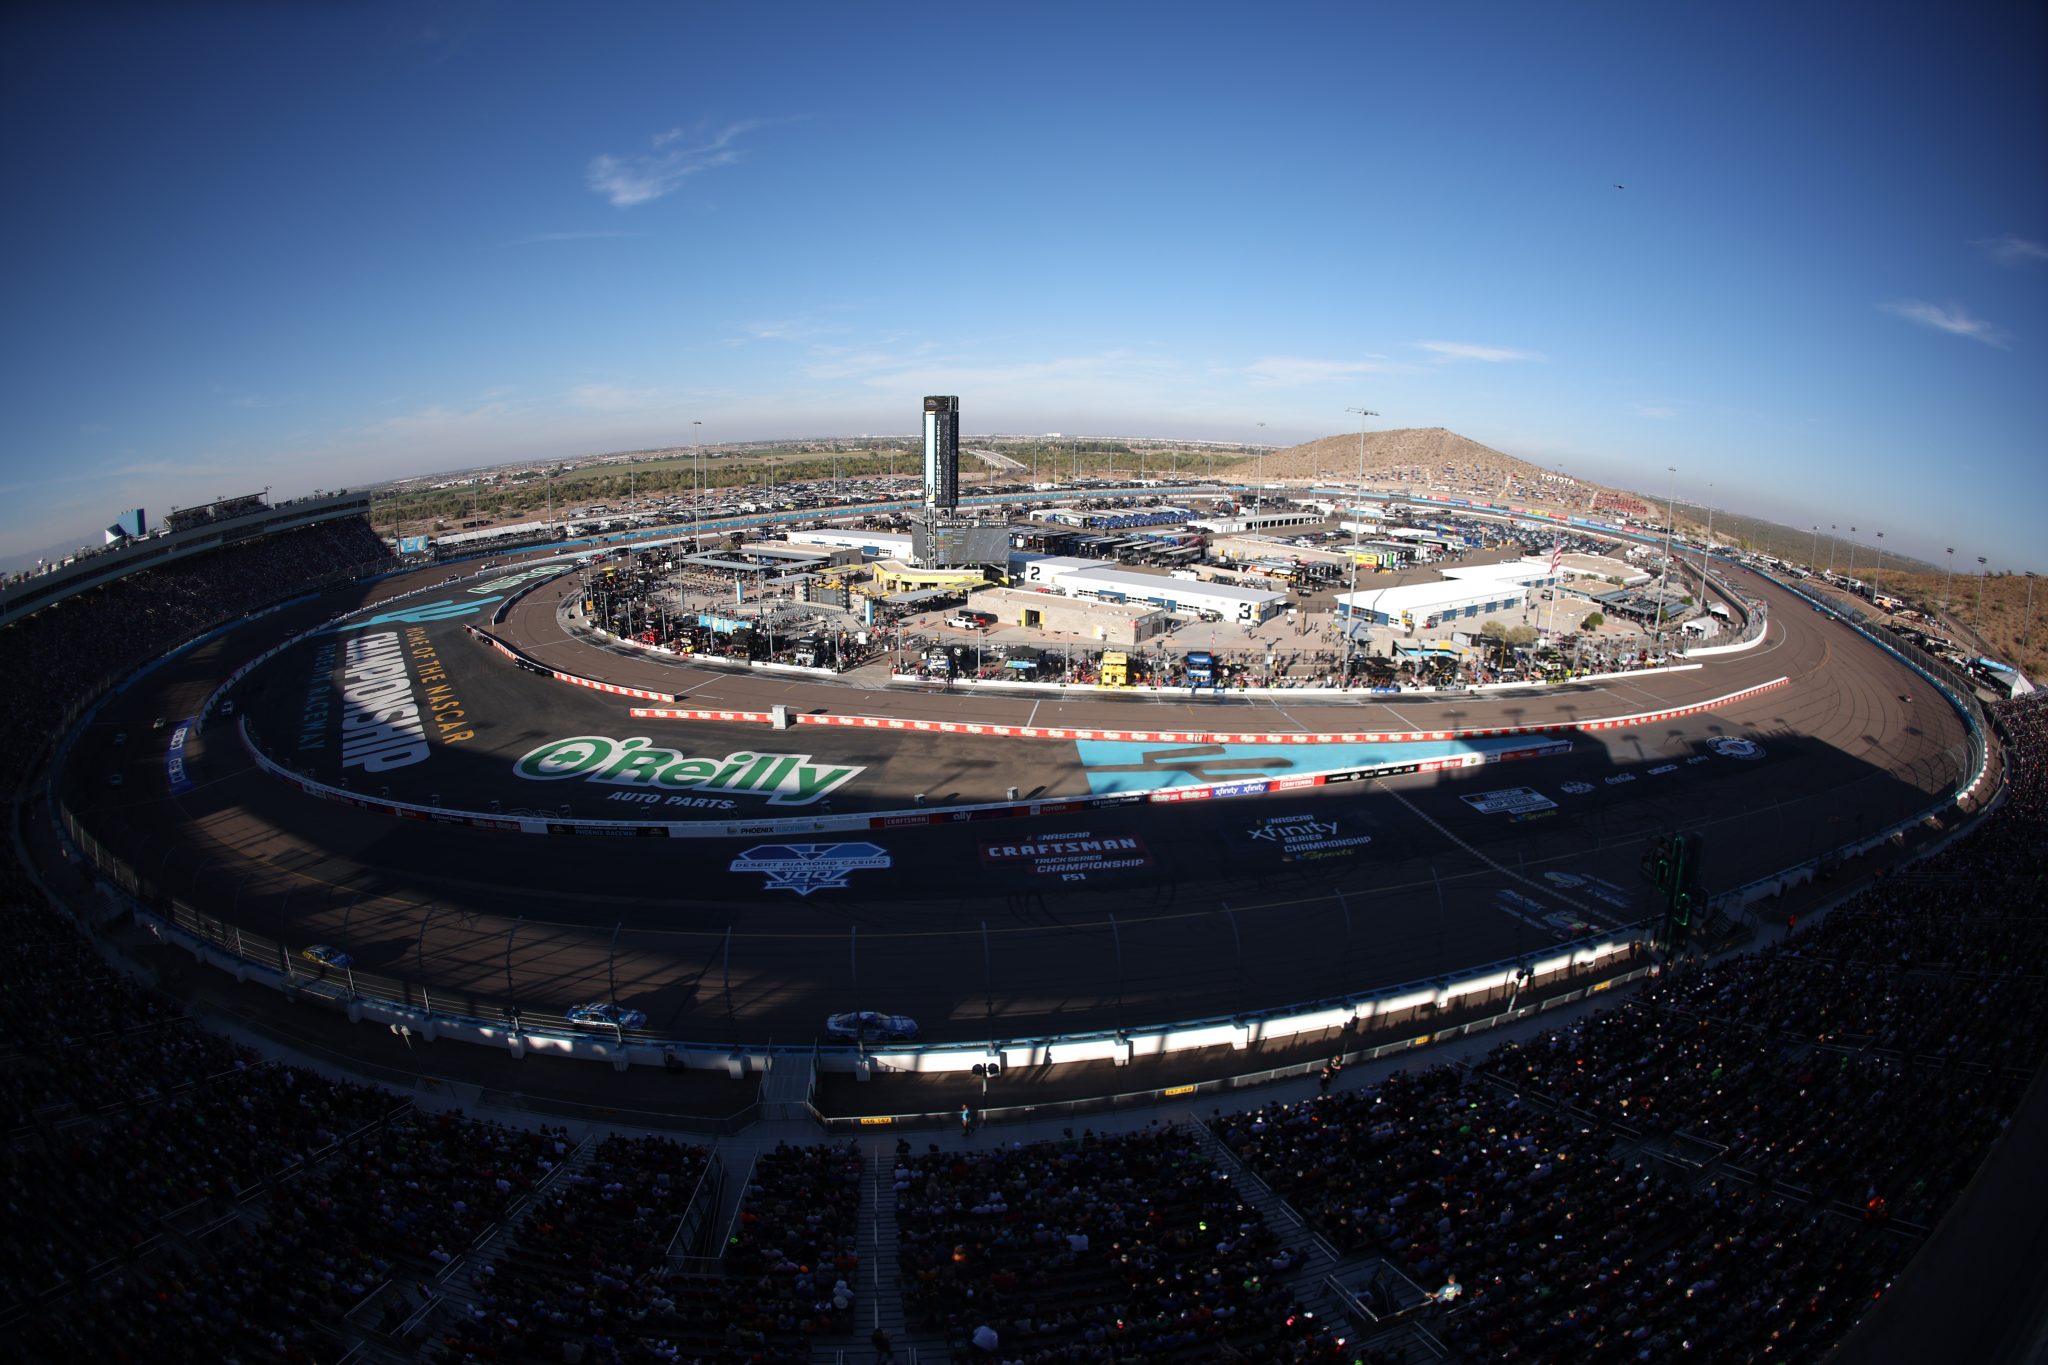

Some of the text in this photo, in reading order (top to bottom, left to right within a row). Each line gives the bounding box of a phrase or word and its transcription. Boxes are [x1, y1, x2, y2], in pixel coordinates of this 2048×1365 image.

[1541, 473, 1575, 486] TOYOTA
[1031, 566, 1040, 580] 2
[1238, 602, 1252, 619] 3
[406, 627, 476, 745] HOME OF THE NASCAR
[342, 631, 432, 773] CHAMPIONSHIP
[297, 685, 333, 751] RACEWAY
[514, 736, 867, 806] O'Reilly
[1214, 786, 1238, 797] xfinity
[1243, 784, 1266, 794] xfinity
[606, 791, 737, 809] AUTO PARTS
[1042, 803, 1067, 811] TOYOTA
[886, 817, 928, 825] CRAFTSMAN
[953, 811, 974, 822] ally
[1270, 814, 1315, 825] NASCAR
[1042, 832, 1091, 841] NASCAR
[1246, 821, 1338, 841] xfinity
[1283, 836, 1372, 853] CHAMPIONSHIP
[1284, 834, 1322, 844] SERIES
[987, 839, 1138, 857] CRAFTSMAN
[1067, 855, 1103, 863] SERIES
[1037, 859, 1145, 874] CHAMPIONSHIP
[784, 870, 832, 880] 100
[1061, 873, 1087, 882] FS1
